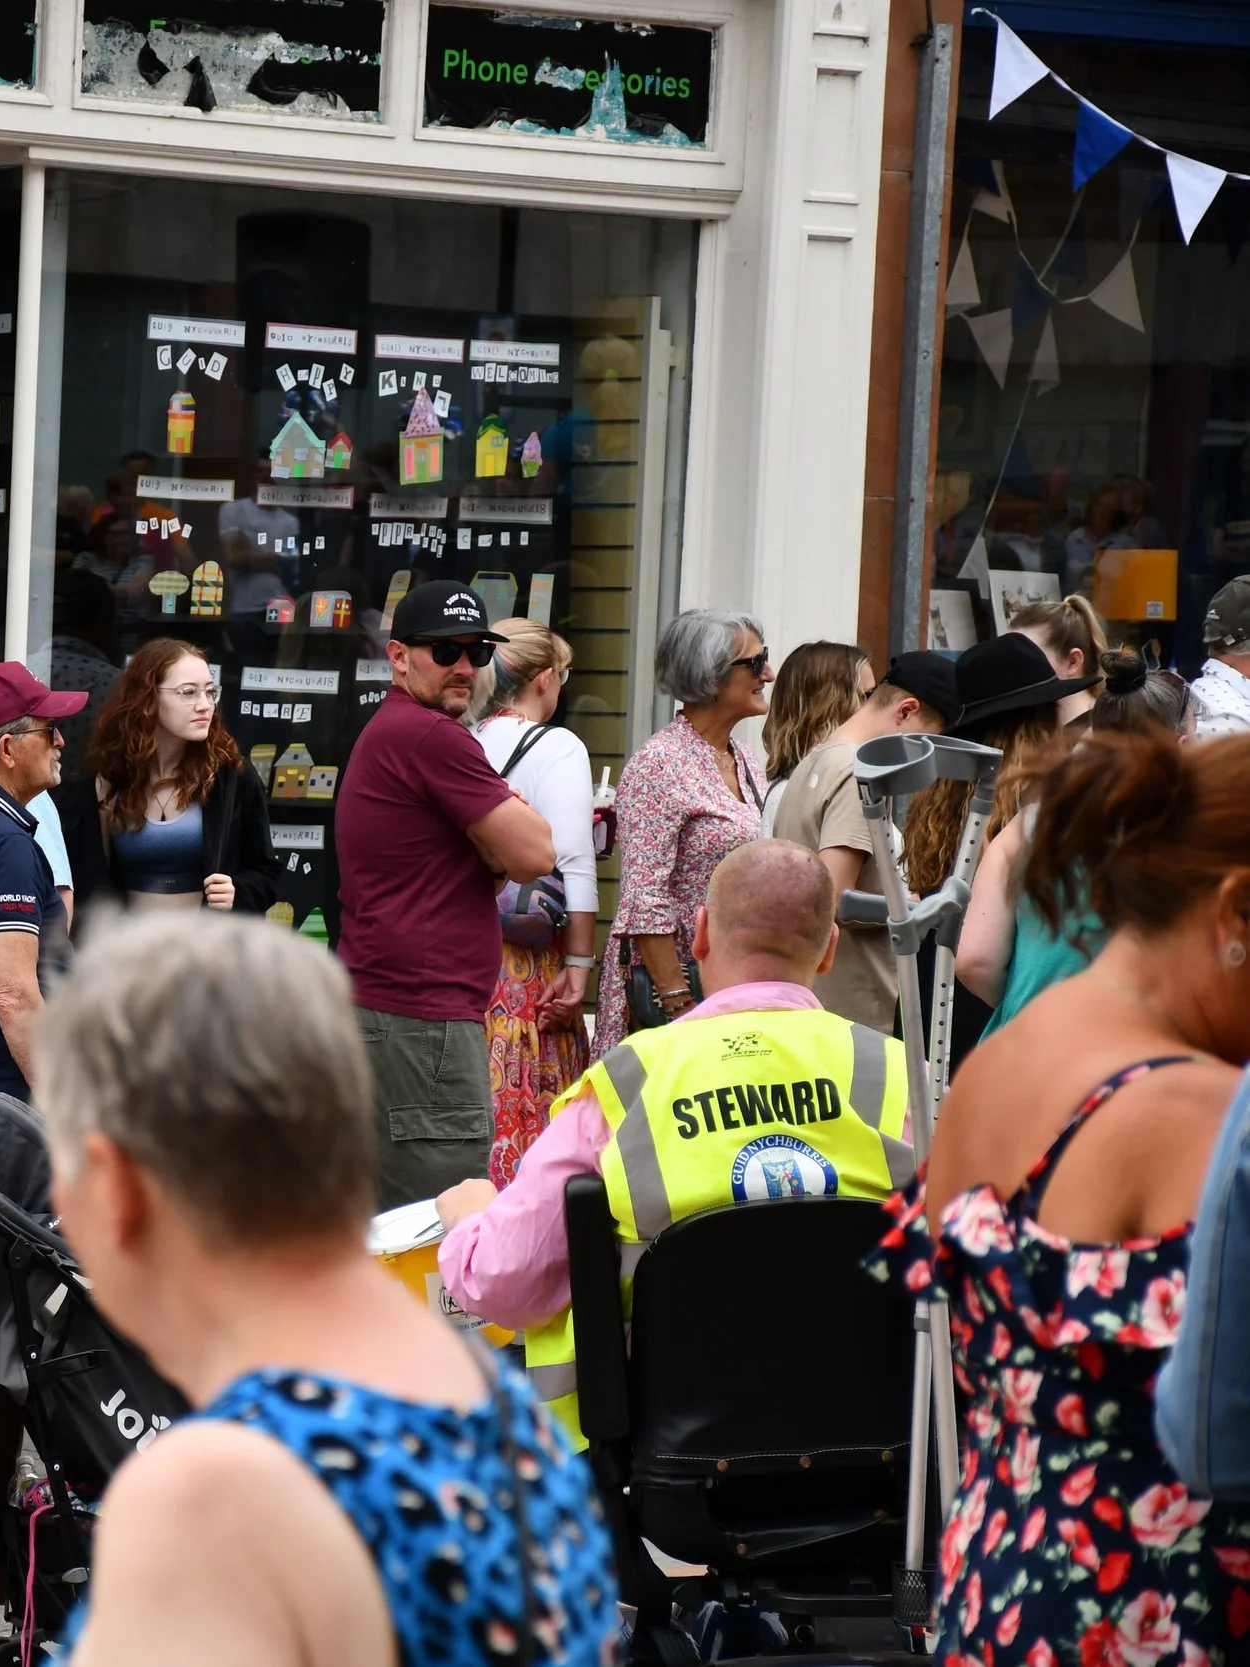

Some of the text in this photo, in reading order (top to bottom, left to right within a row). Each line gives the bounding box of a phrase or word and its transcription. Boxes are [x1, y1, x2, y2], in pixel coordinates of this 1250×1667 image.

[443, 49, 528, 84] Phone
[159, 346, 222, 375] GUID
[443, 607, 467, 616] SANTA
[672, 1078, 842, 1140] STEWARD
[732, 1134, 830, 1185] GUID NYCHBURRIS
[100, 1389, 172, 1456] Joi
